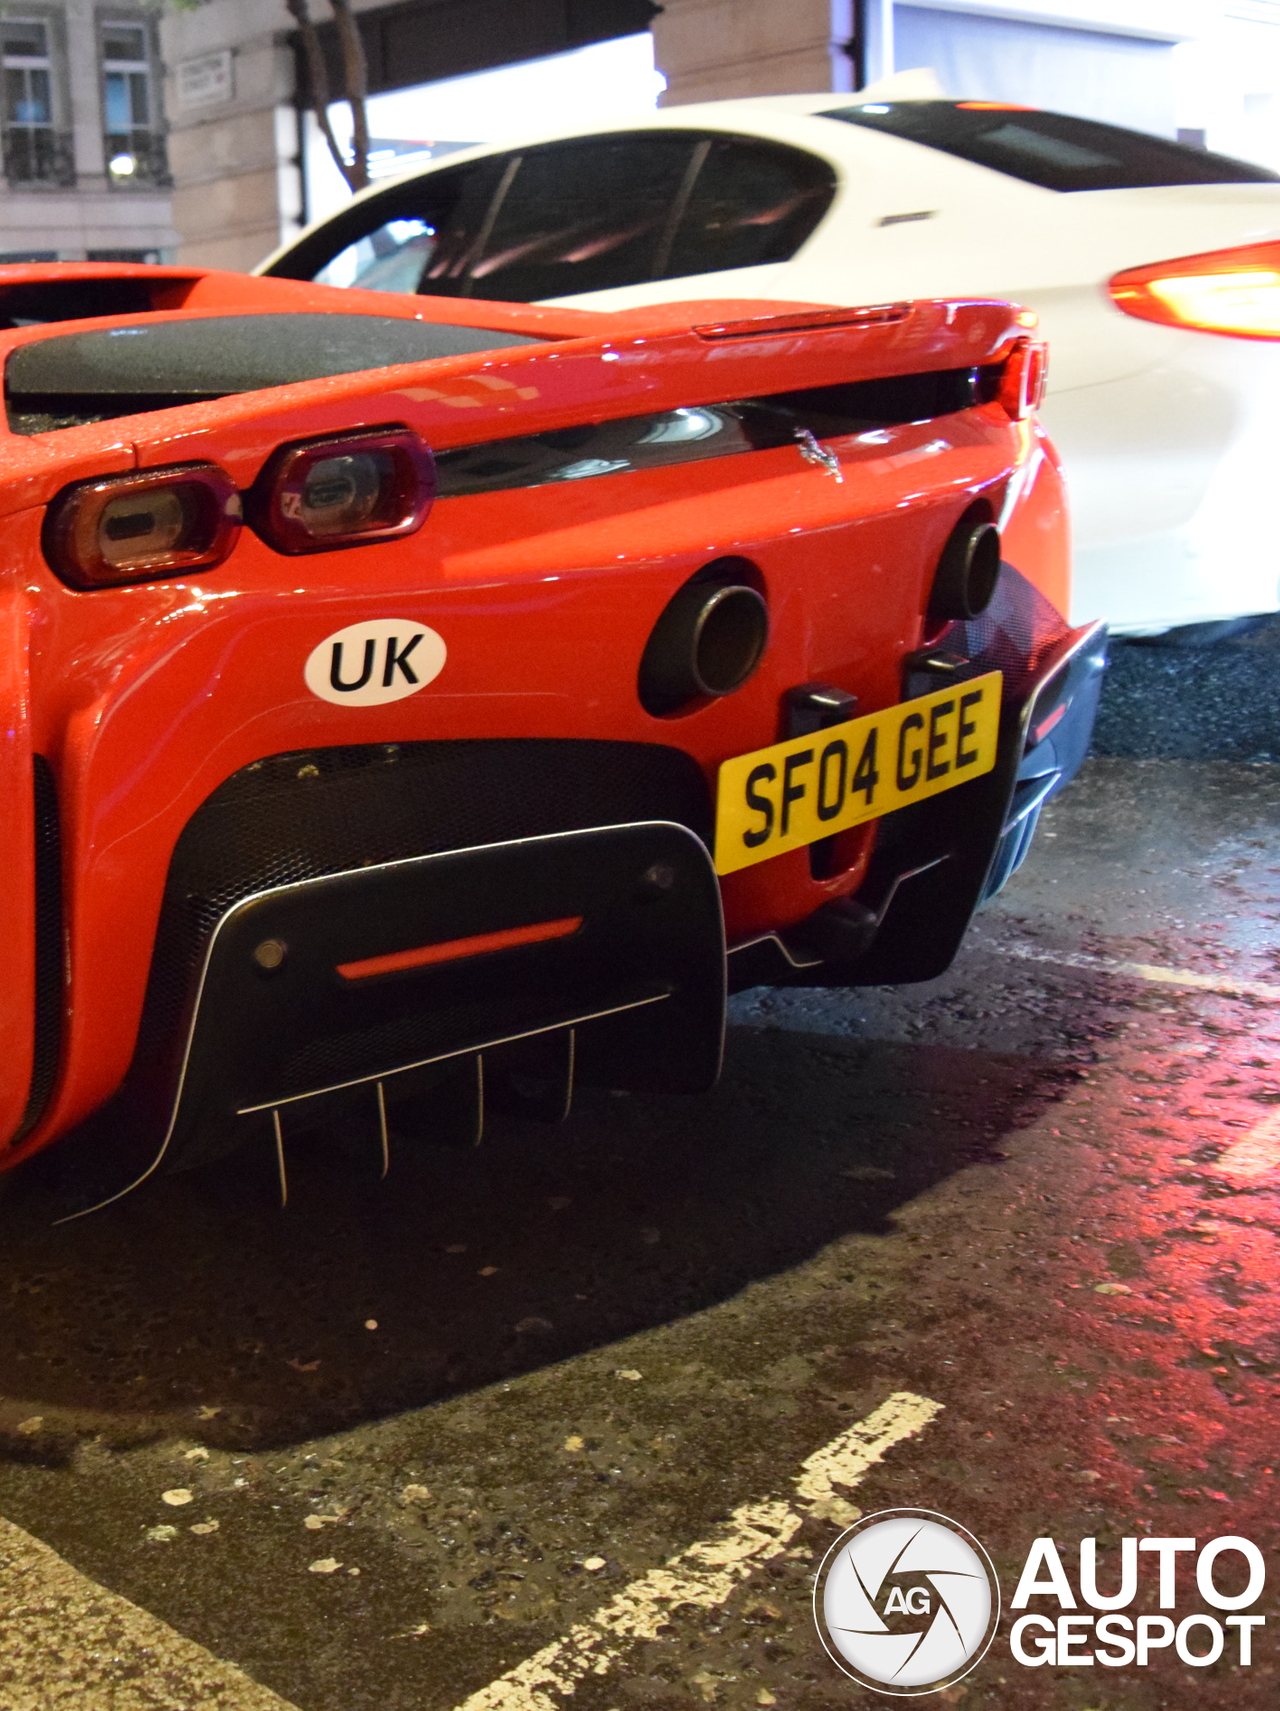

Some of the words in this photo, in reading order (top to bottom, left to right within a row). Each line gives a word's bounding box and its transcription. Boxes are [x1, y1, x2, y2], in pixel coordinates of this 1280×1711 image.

[330, 633, 425, 692] UK
[742, 727, 879, 849] SF04
[896, 689, 984, 792] GEE
